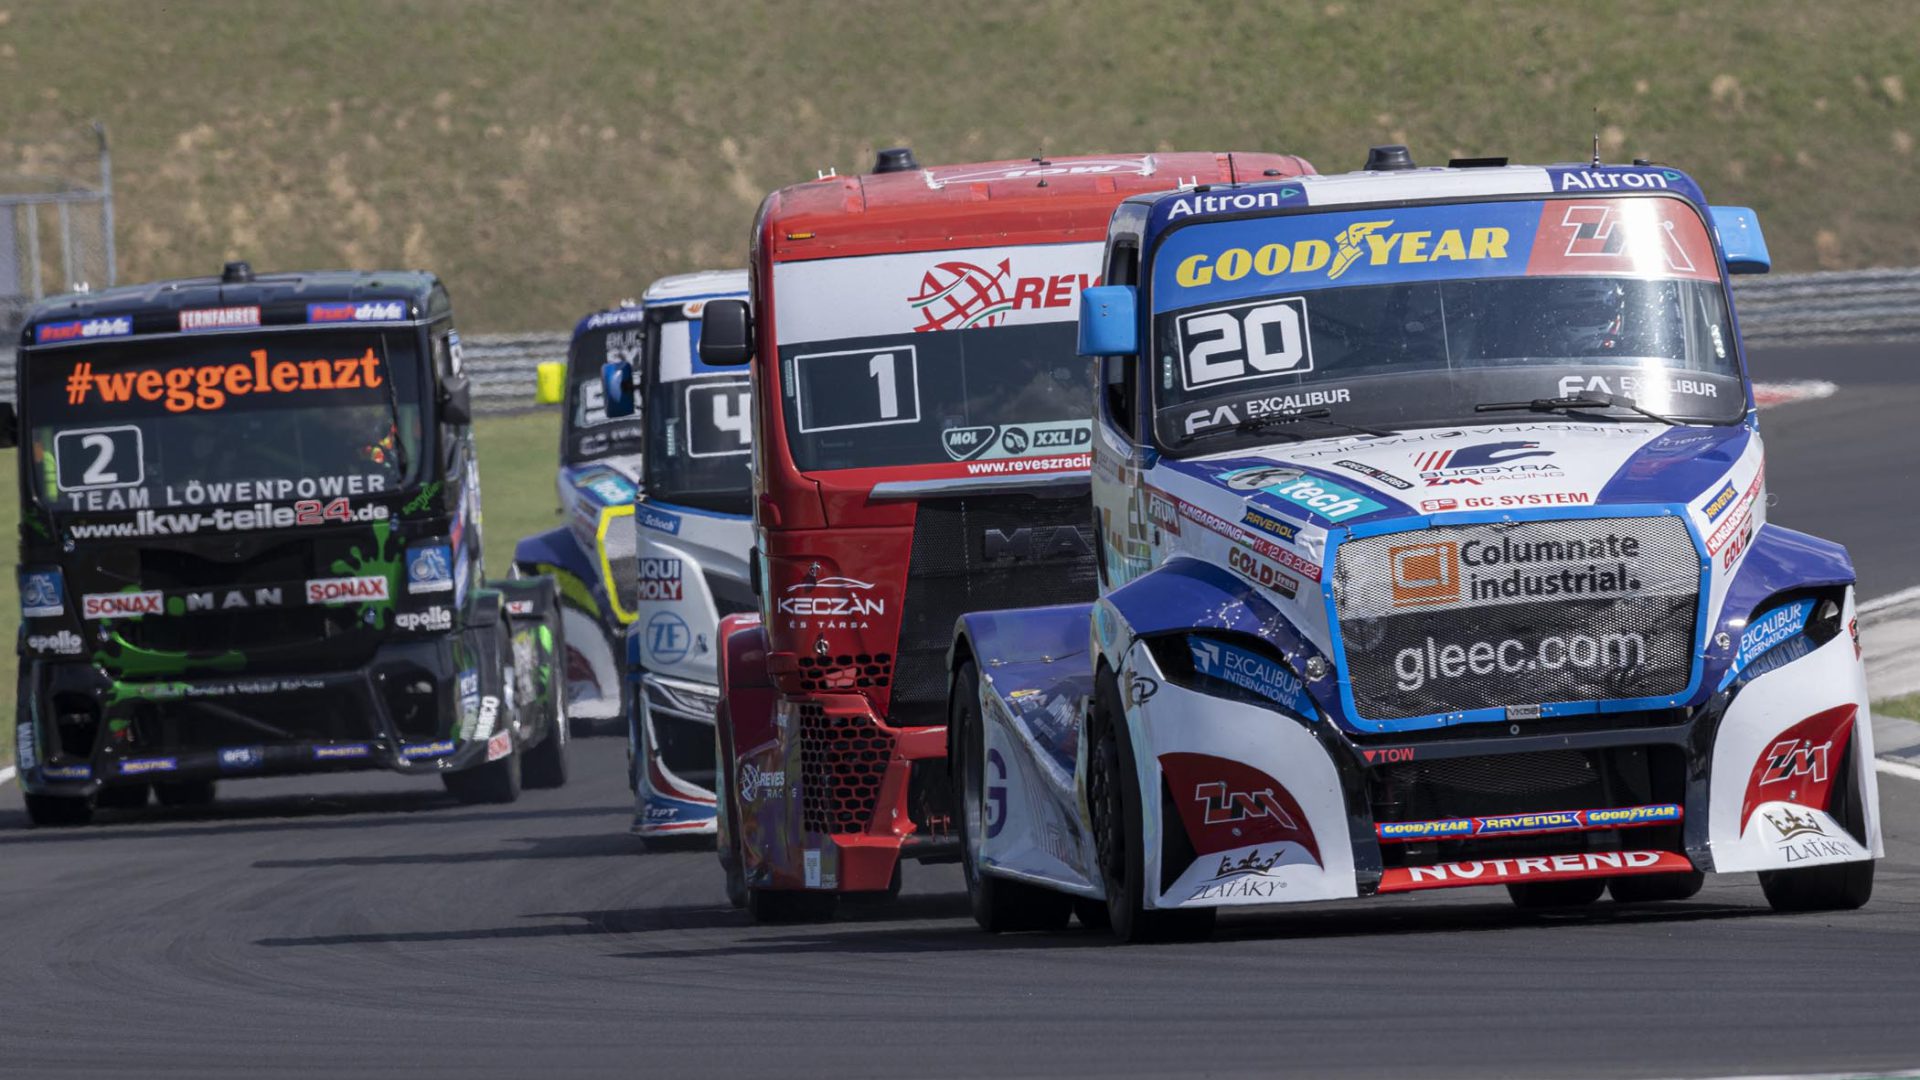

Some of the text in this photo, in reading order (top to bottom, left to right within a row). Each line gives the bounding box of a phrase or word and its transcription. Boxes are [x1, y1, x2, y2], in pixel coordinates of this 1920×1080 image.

[1562, 171, 1668, 190] Altron
[1168, 192, 1279, 220] Altron
[1187, 304, 1303, 384] 20
[66, 348, 382, 412] #weggelenzt
[869, 354, 898, 418] 1
[1620, 376, 1718, 398] EXLIBUR
[1246, 389, 1351, 414] EXCALIBUR
[713, 393, 752, 444] 4
[949, 431, 978, 446] MOL
[1035, 430, 1070, 446] XXL
[81, 434, 119, 485] 2
[1419, 463, 1560, 479] BUGGYRA
[1480, 471, 1565, 482] RACING
[68, 487, 150, 512] TEAM
[167, 474, 386, 506] LÖWENPOWER
[1279, 480, 1363, 518] tech
[1500, 491, 1589, 506] SYSTEM
[70, 497, 389, 539] www.lkw-teile24.de
[1178, 502, 1244, 542] HUNGARORING
[1246, 511, 1296, 539] RAVENOL
[1461, 534, 1640, 566] Columnate
[639, 560, 680, 579] IQUI
[1228, 546, 1275, 586] GOLD
[310, 578, 385, 601] SONAX
[1471, 563, 1641, 600] industrial.
[86, 594, 161, 614] SONAX
[186, 588, 283, 612] MAN
[395, 606, 451, 631] apollo
[1740, 603, 1802, 652] EXCALIBUR
[28, 630, 82, 653] apollo
[1743, 620, 1803, 664] INTERNATIONAL
[1224, 651, 1303, 698] EXCALIBUR
[1394, 631, 1646, 692] gleec.com
[1222, 668, 1298, 710] INTERNATIONAL
[1379, 748, 1415, 763] TOW
[1758, 739, 1833, 787] ZM
[1194, 781, 1299, 831] ZM
[1590, 806, 1675, 821] GOODYEAR
[1384, 820, 1469, 835] GOODYEAR
[1486, 813, 1572, 829] RAVENOL
[1408, 851, 1662, 882] NUTREND
